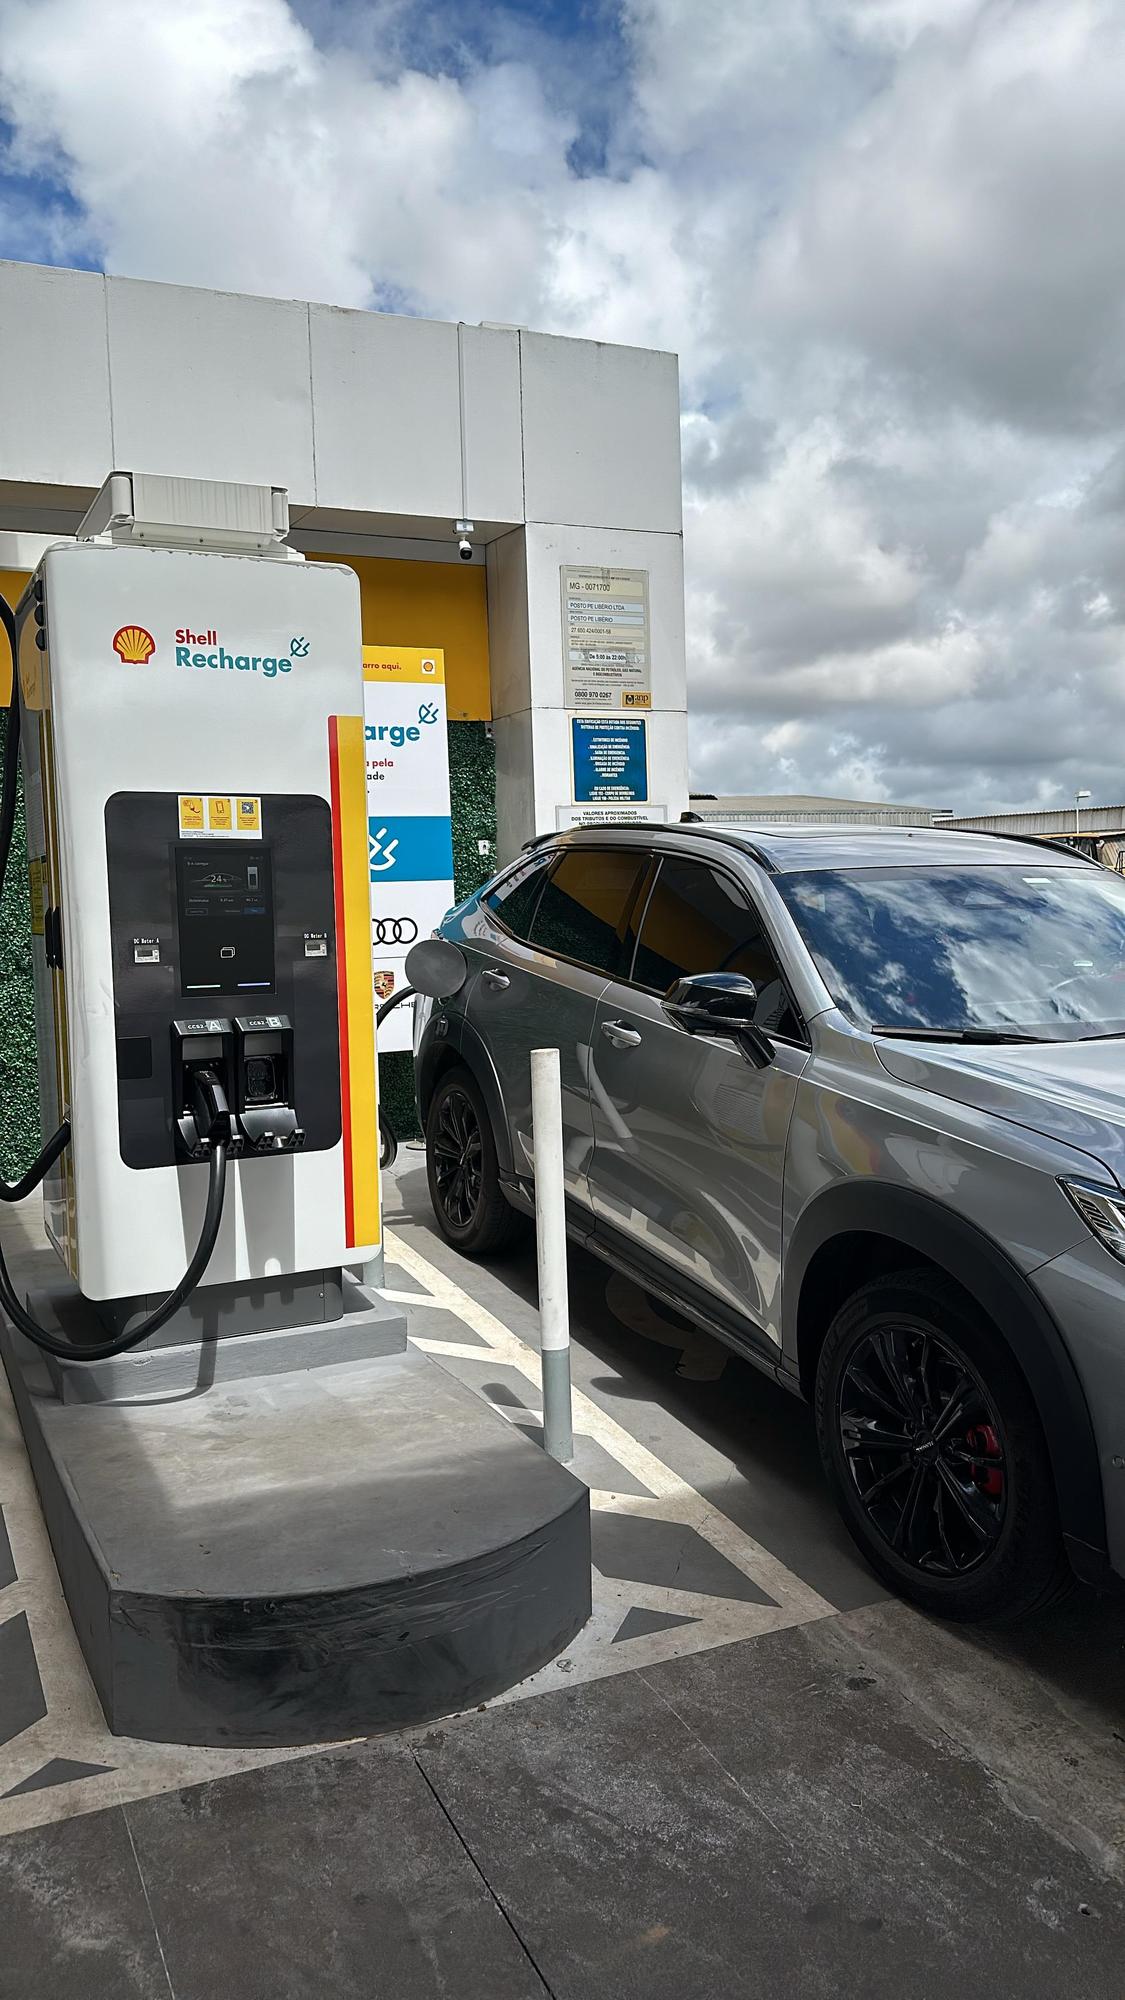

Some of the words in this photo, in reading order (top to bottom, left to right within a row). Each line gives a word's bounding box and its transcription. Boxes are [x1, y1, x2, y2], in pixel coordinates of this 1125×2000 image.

[175, 629, 217, 645] Shell
[175, 646, 292, 678] Recharge
[381, 662, 401, 671] aqui.
[365, 726, 420, 747] arge
[372, 758, 394, 769] pela
[367, 771, 385, 780] ade
